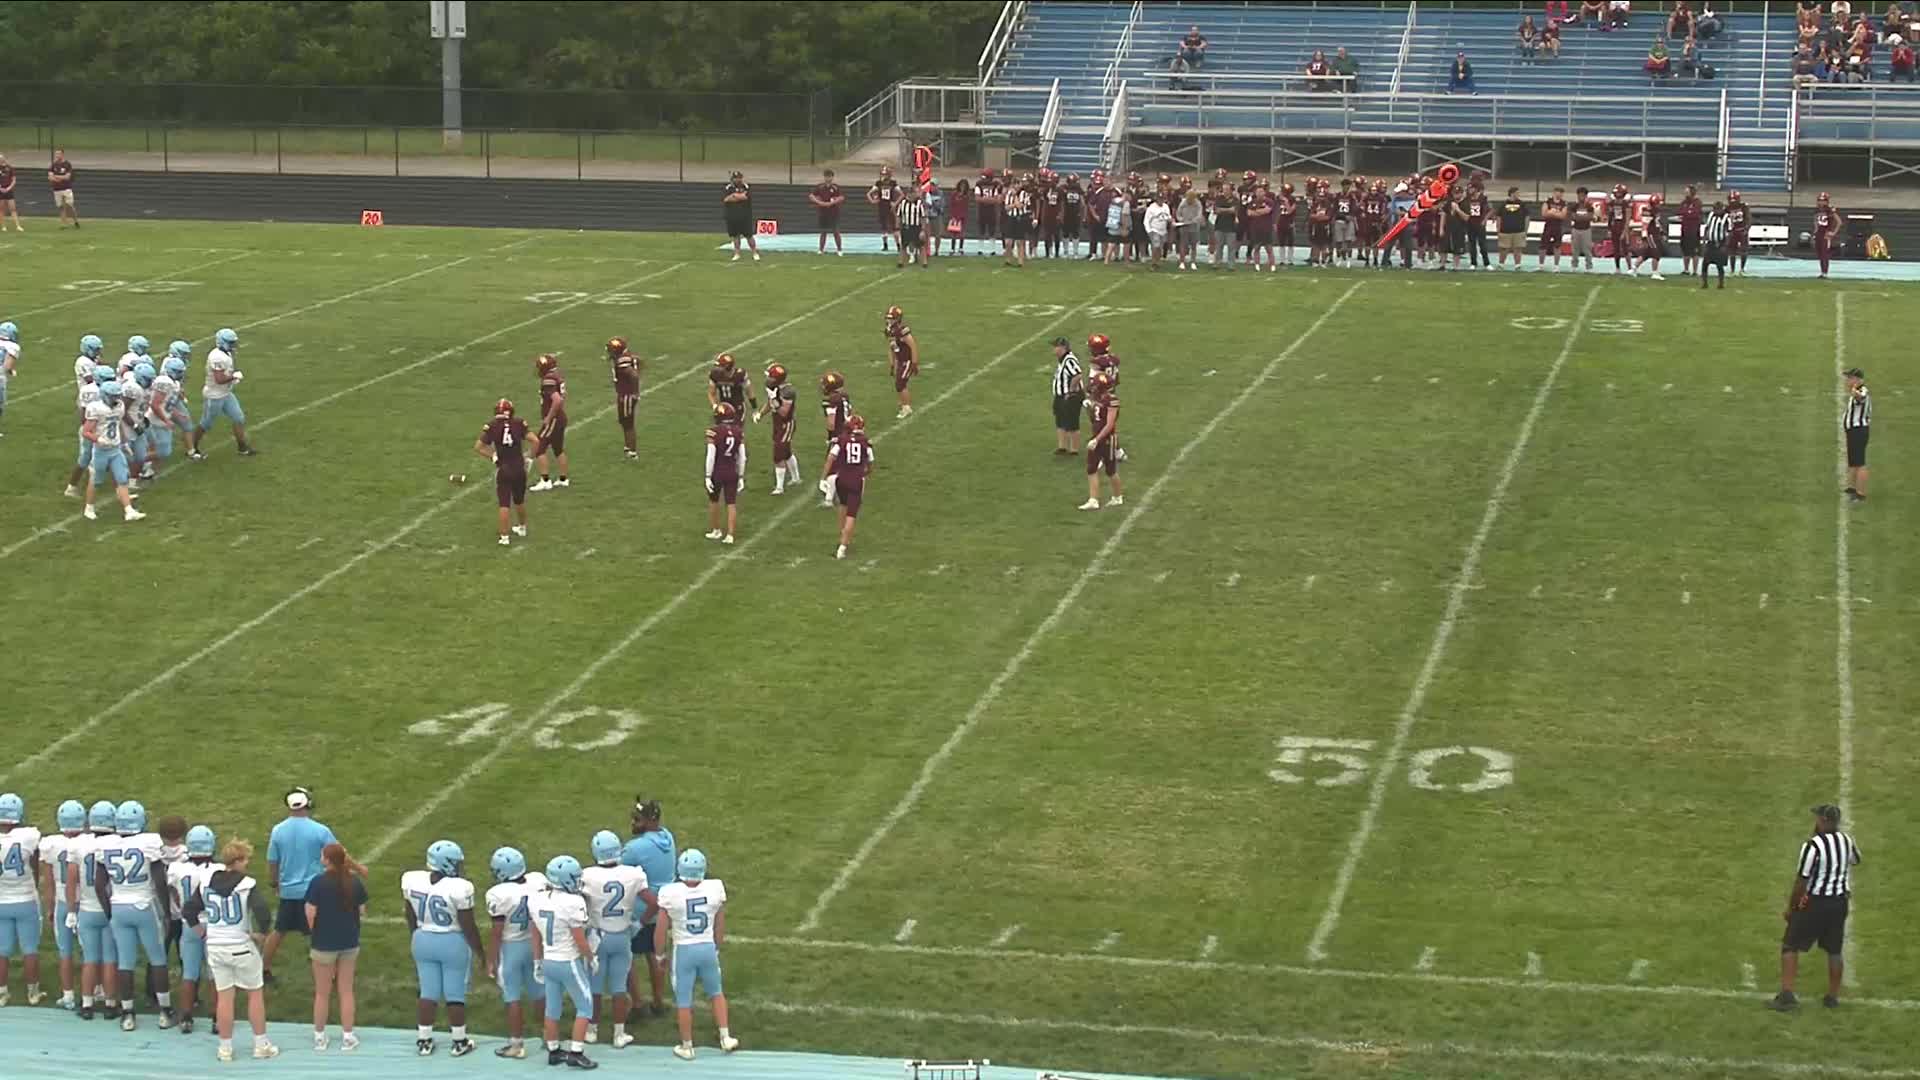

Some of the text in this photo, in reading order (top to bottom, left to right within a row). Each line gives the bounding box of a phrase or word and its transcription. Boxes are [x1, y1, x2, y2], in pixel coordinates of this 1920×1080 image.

[364, 212, 379, 225] 20
[759, 221, 775, 234] 30
[502, 427, 514, 447] 4
[724, 437, 735, 457] 2
[846, 442, 861, 464] 19
[407, 702, 642, 751] 40
[1265, 736, 1514, 793] 50
[0, 843, 24, 876] 4
[103, 847, 149, 885] 52
[203, 886, 243, 925] 50
[410, 890, 453, 926] 76
[602, 880, 625, 918] 2
[686, 896, 708, 935] 5
[539, 909, 555, 946] 7
